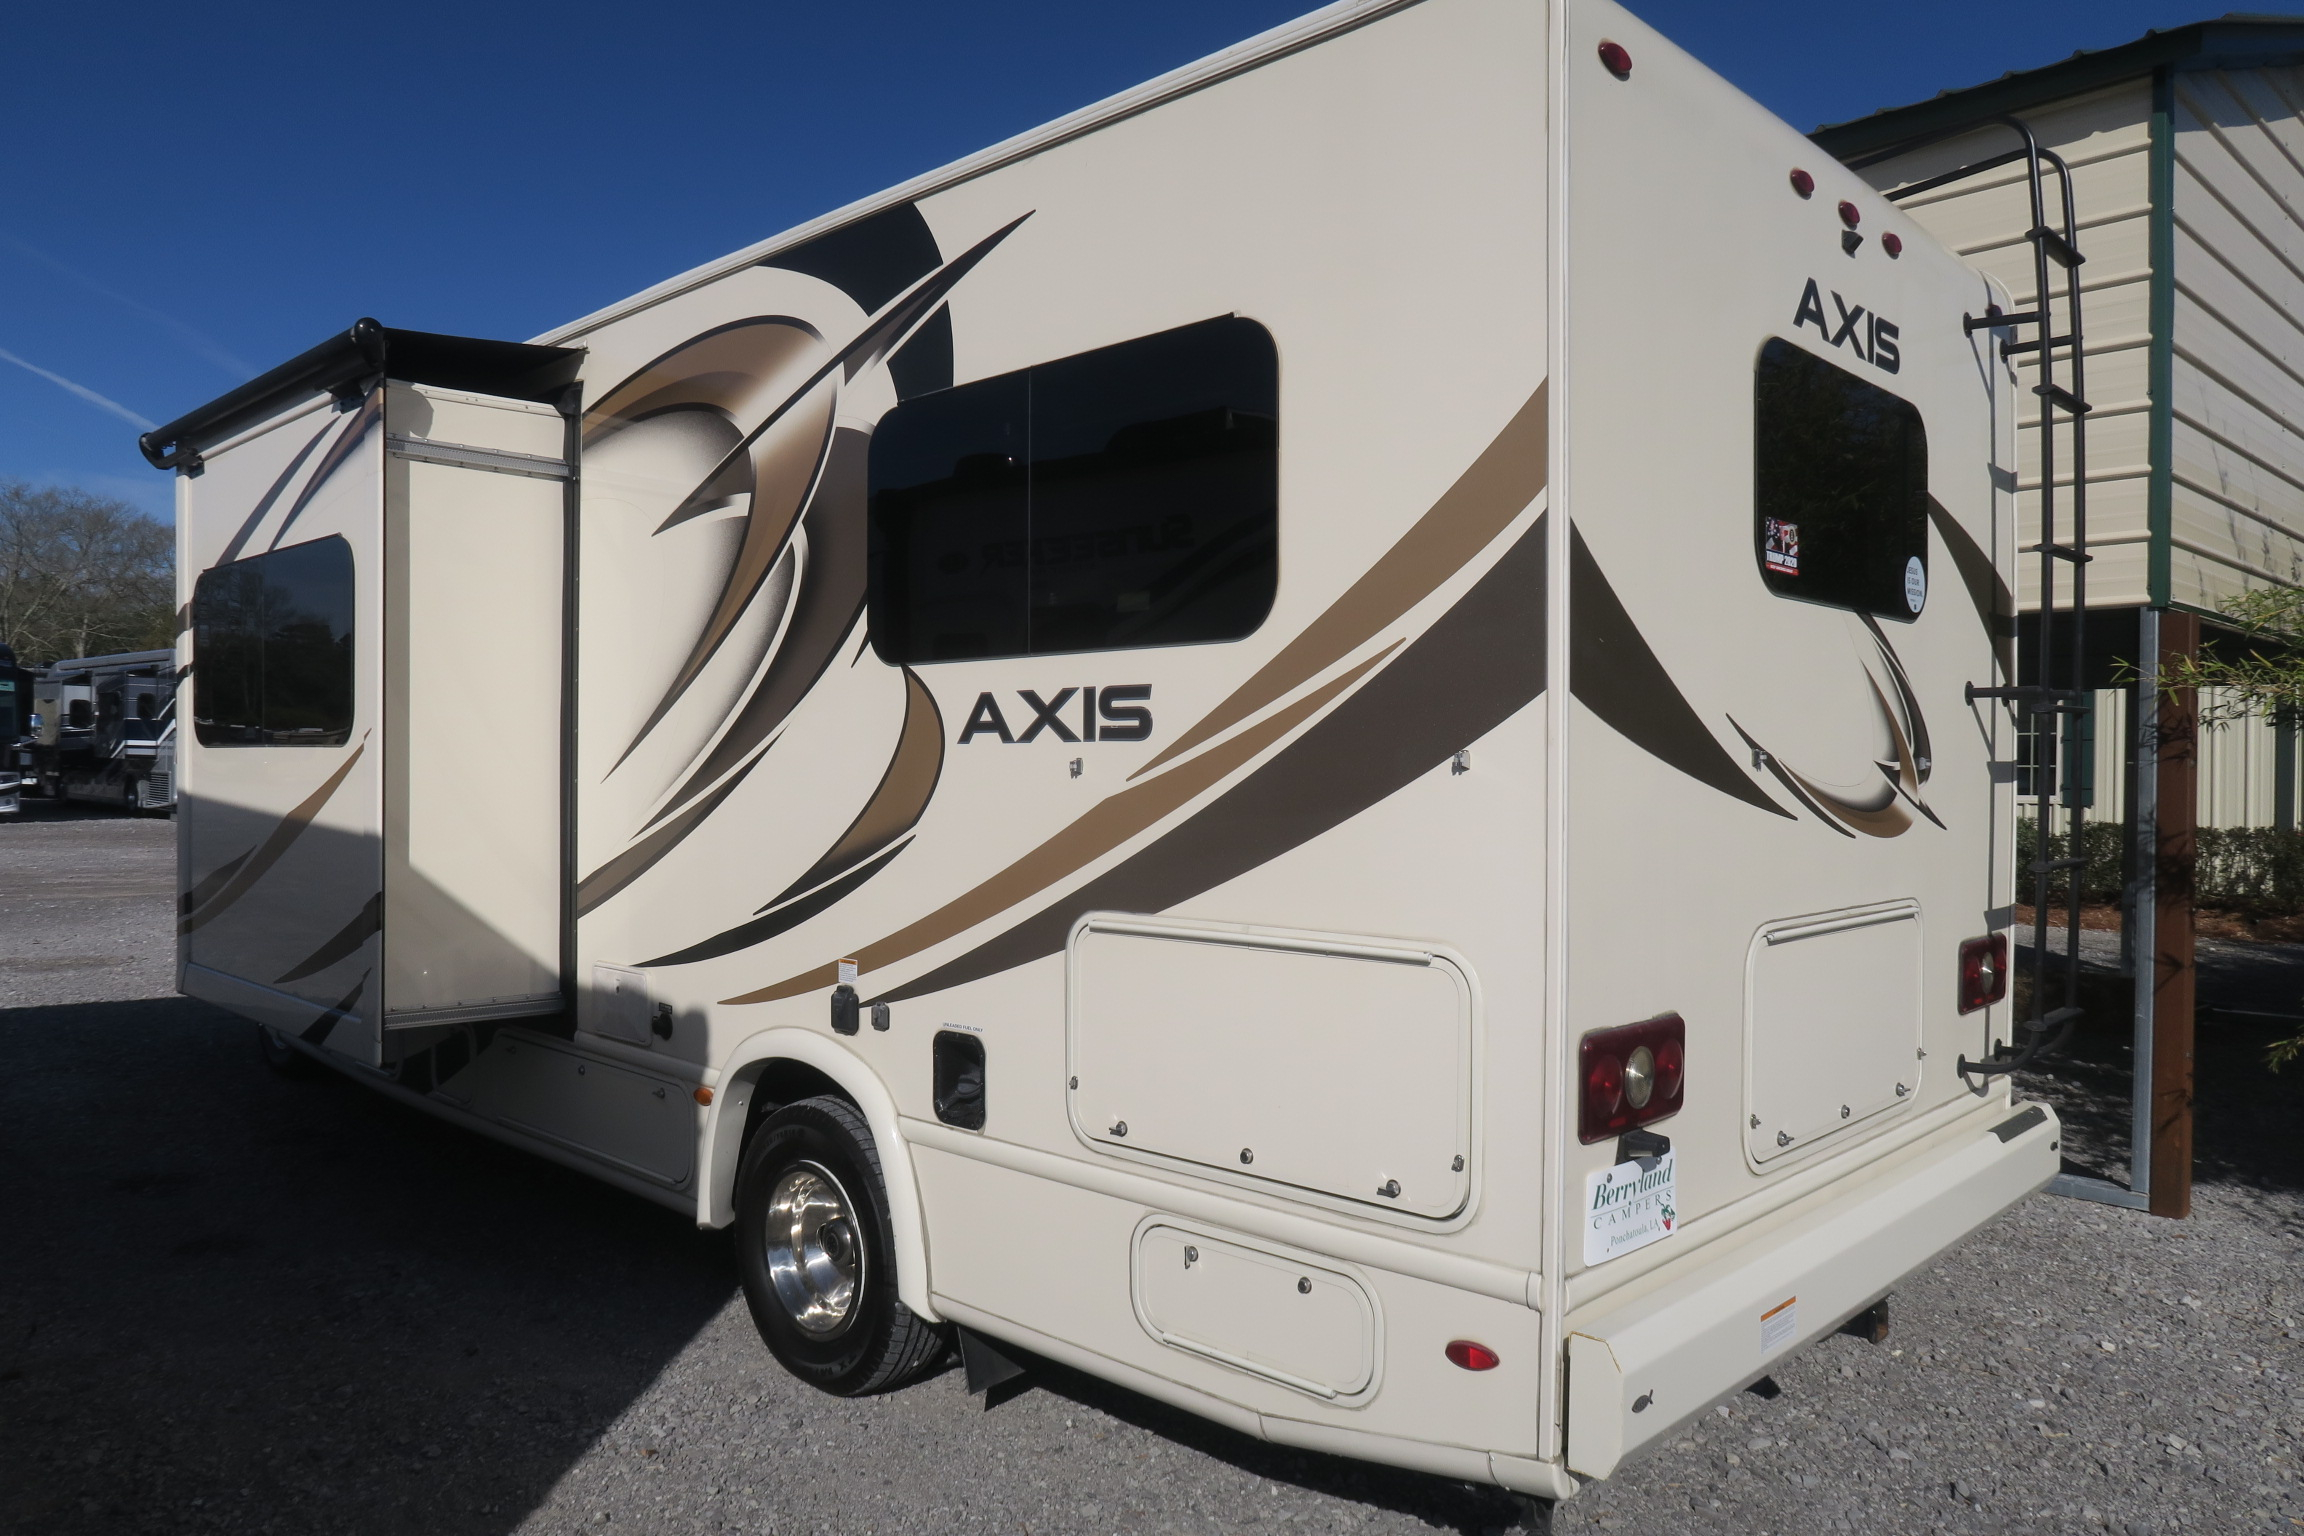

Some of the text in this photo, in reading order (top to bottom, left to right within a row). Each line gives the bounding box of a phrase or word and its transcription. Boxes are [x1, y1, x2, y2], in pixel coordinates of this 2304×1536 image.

[1793, 277, 1900, 375] AXIS
[957, 684, 1153, 744] AXIS
[1592, 1158, 1673, 1210] Berryland
[1593, 1190, 1672, 1230] CAMPERS
[1650, 1218, 1659, 1231] LA
